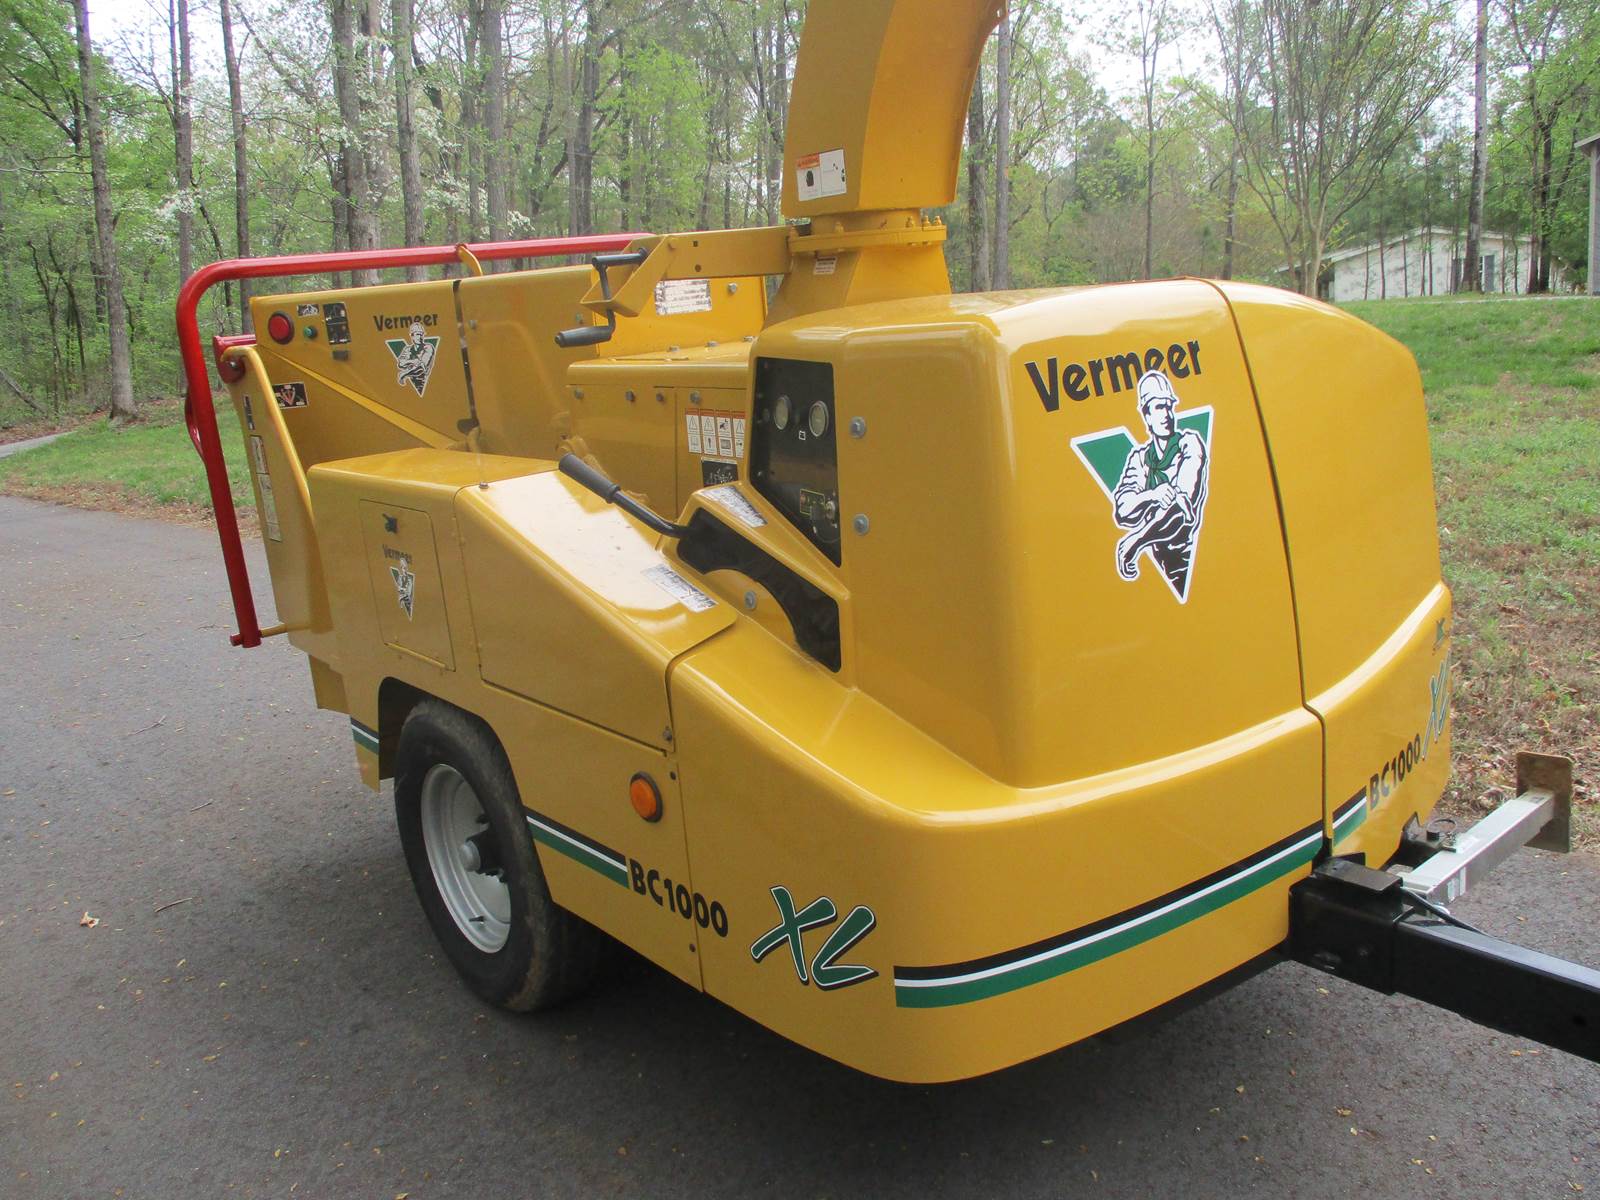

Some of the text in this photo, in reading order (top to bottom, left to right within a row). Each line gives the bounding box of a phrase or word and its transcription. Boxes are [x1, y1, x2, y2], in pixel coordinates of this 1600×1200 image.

[373, 313, 439, 332] Vermeer
[1024, 340, 1201, 413] Vermeer
[1369, 733, 1421, 811] BC1000
[629, 858, 879, 991] BC1000 XL
